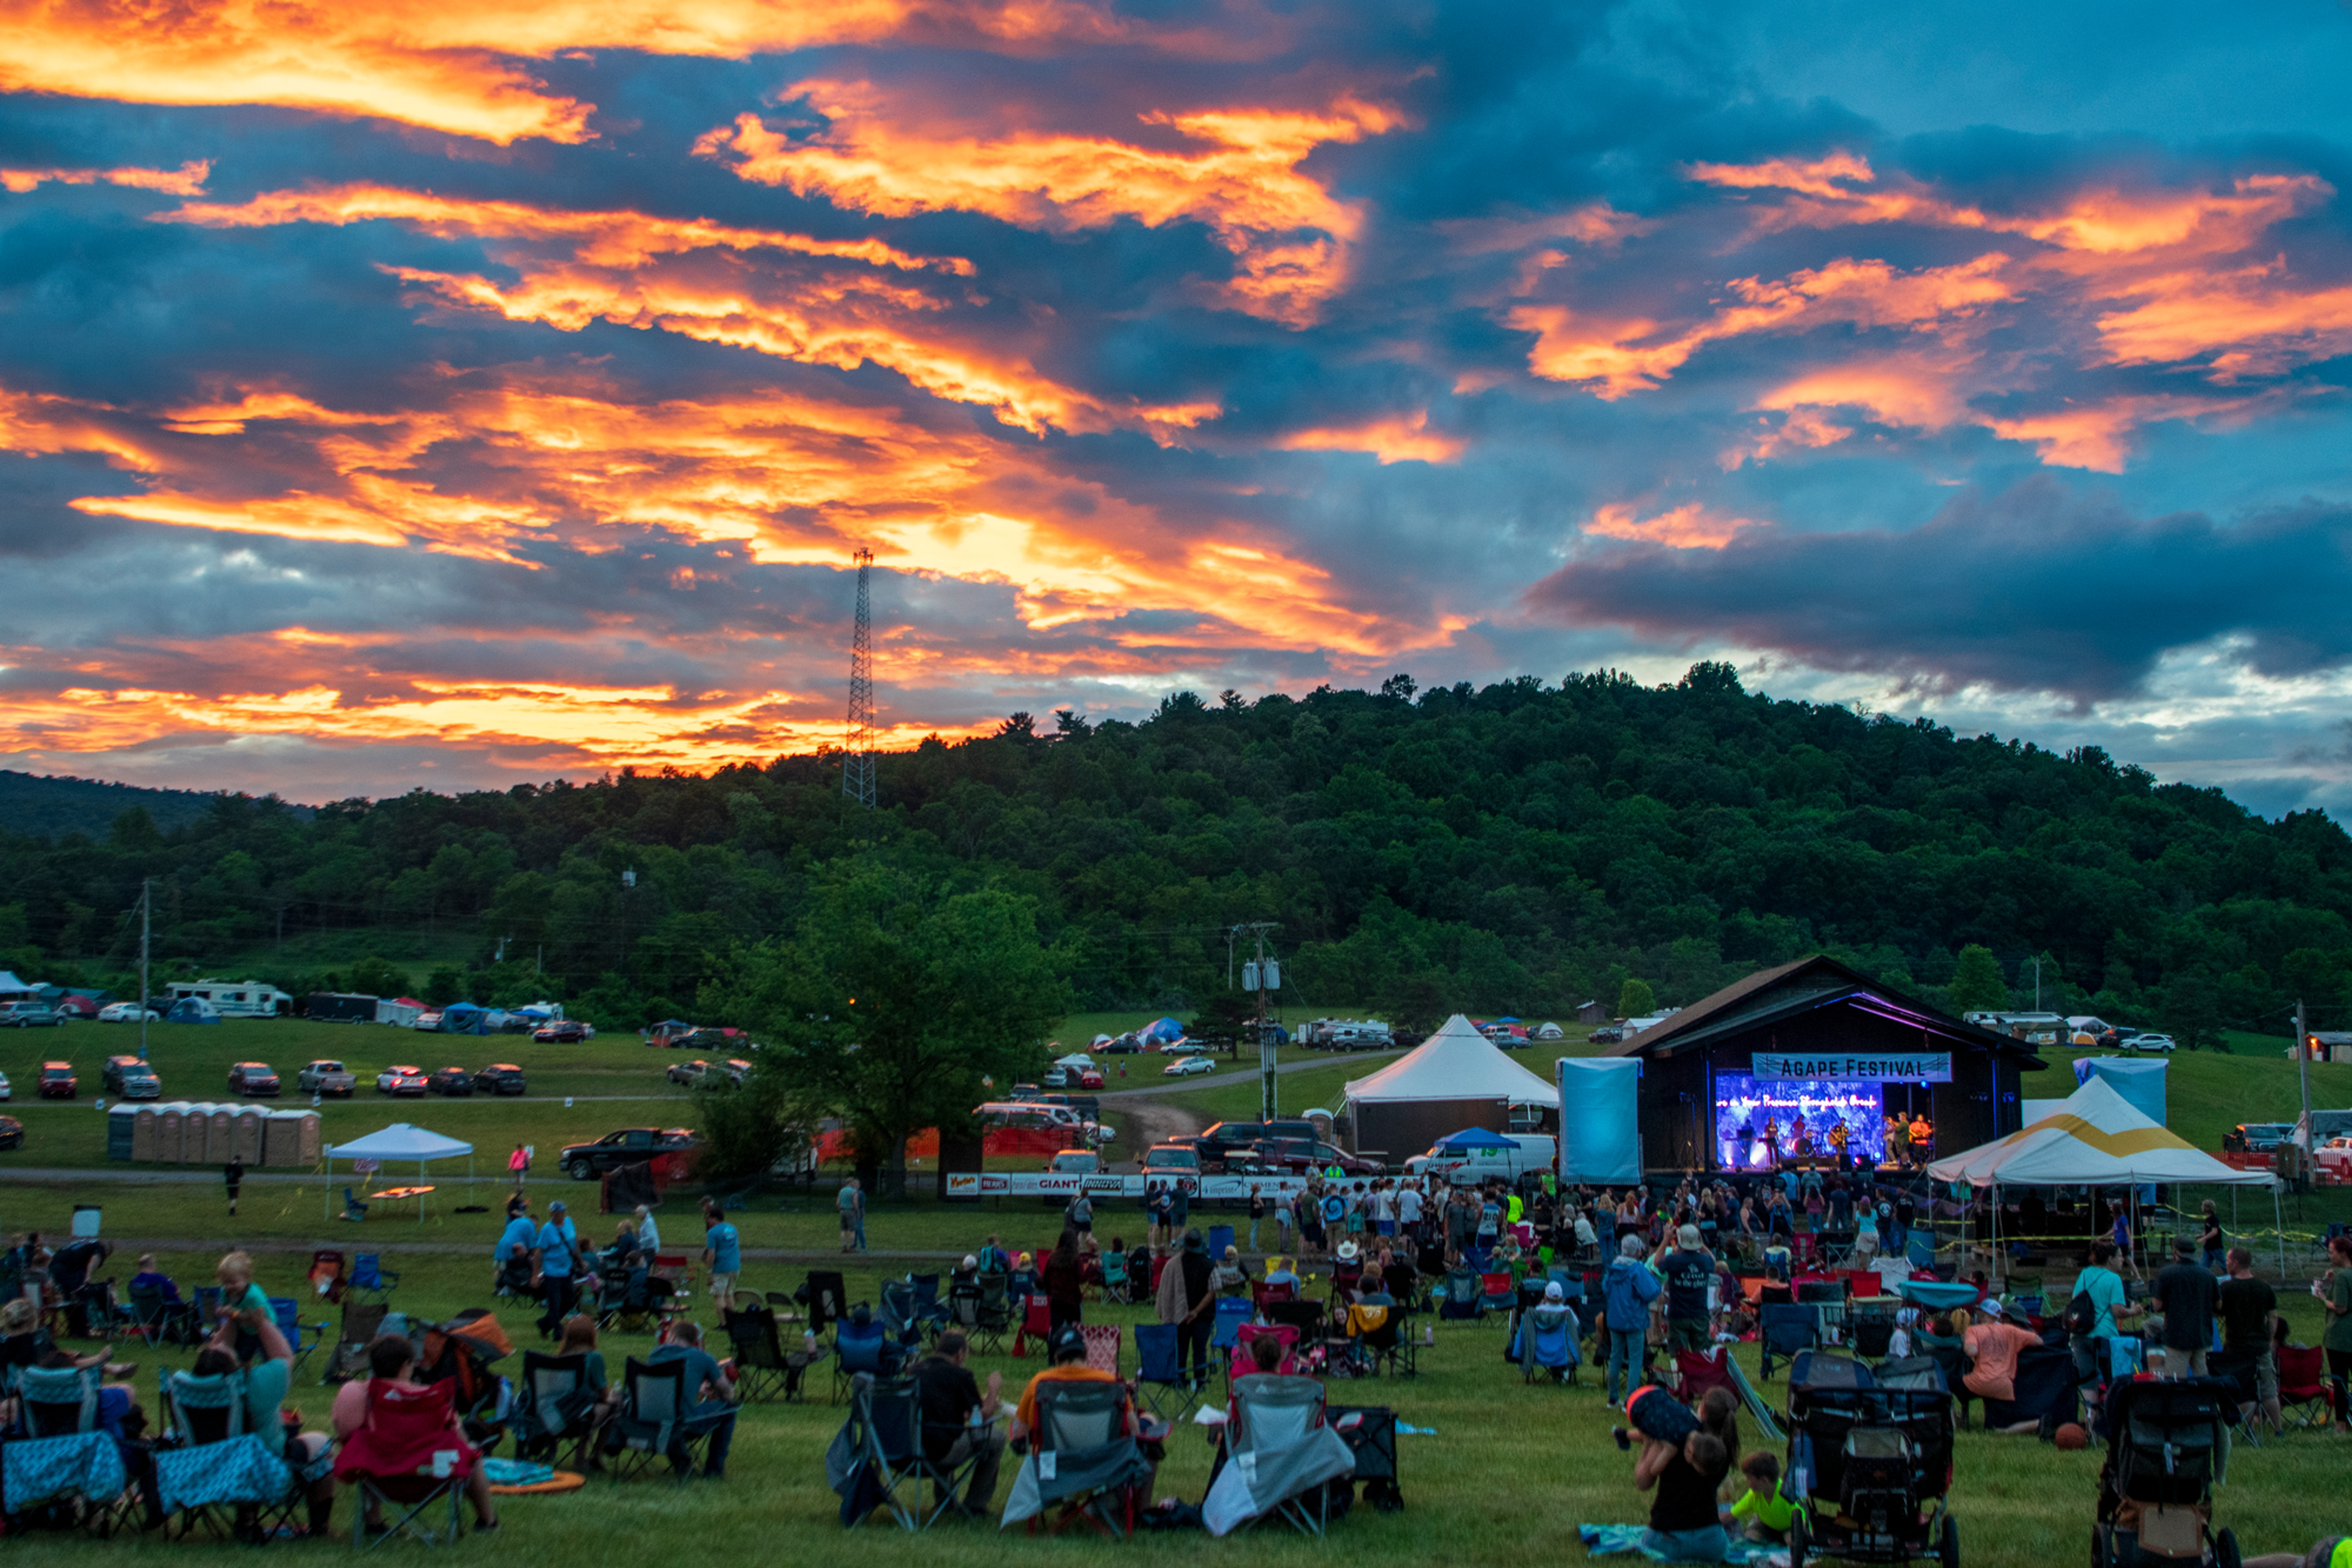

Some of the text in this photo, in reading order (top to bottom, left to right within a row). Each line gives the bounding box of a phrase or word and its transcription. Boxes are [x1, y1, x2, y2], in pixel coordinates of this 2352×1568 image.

[1781, 1059, 1925, 1076] AGAPE FESTIVAL
[1039, 1179, 1079, 1189] GIANT
